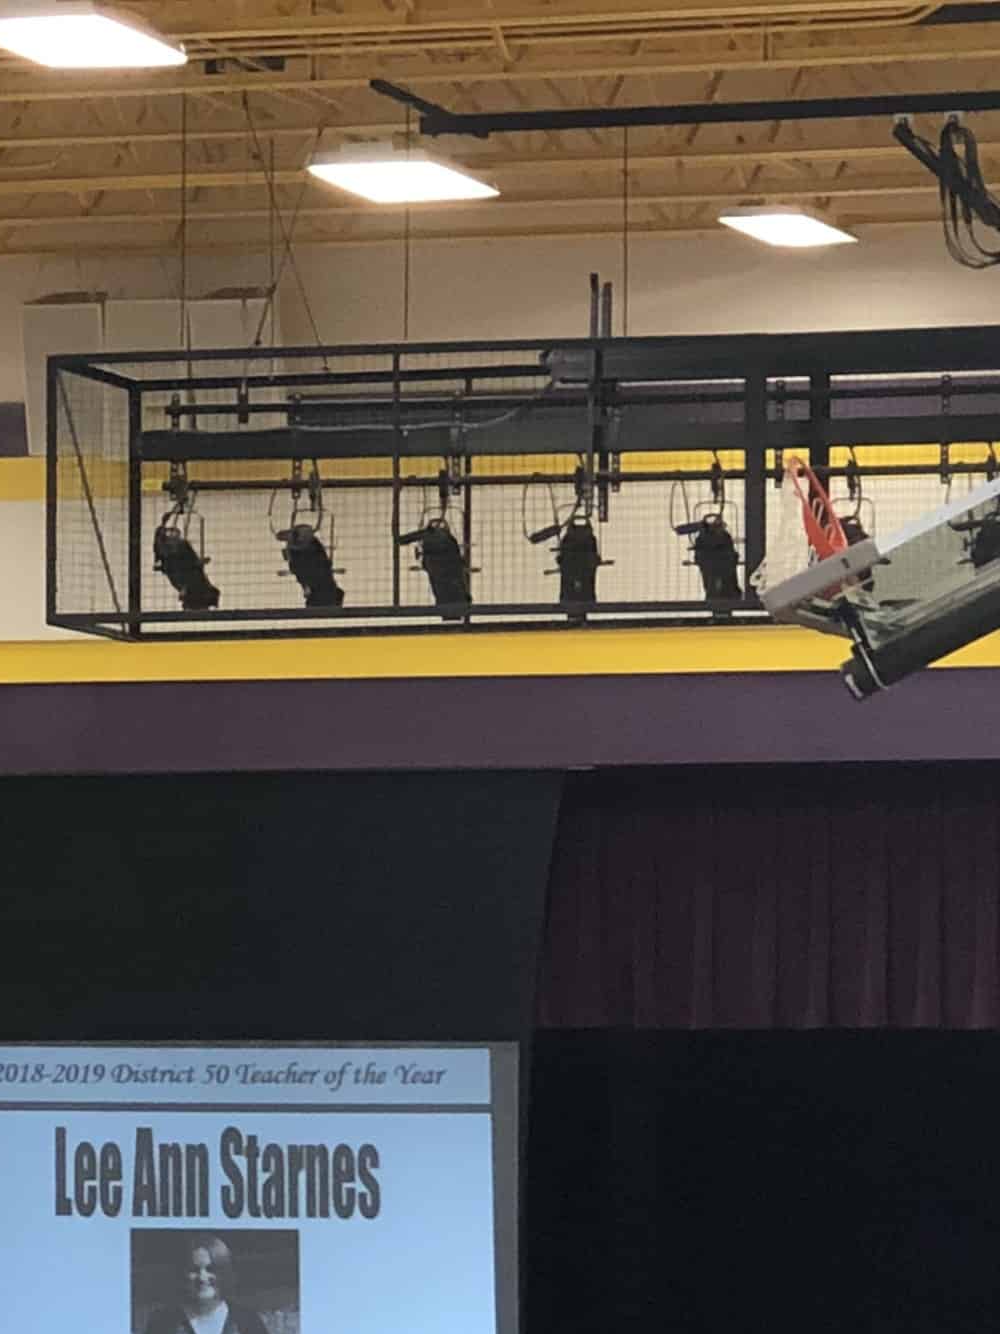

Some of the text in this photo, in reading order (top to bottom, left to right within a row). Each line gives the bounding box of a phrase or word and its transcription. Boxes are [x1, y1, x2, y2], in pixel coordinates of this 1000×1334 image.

[110, 1063, 195, 1084] District
[201, 1064, 230, 1084] 50
[235, 1061, 321, 1084] Teacher
[323, 1061, 353, 1092] of
[353, 1062, 388, 1085] the
[393, 1065, 448, 1085] Year
[55, 1126, 381, 1218] Lee Ann Starnes
